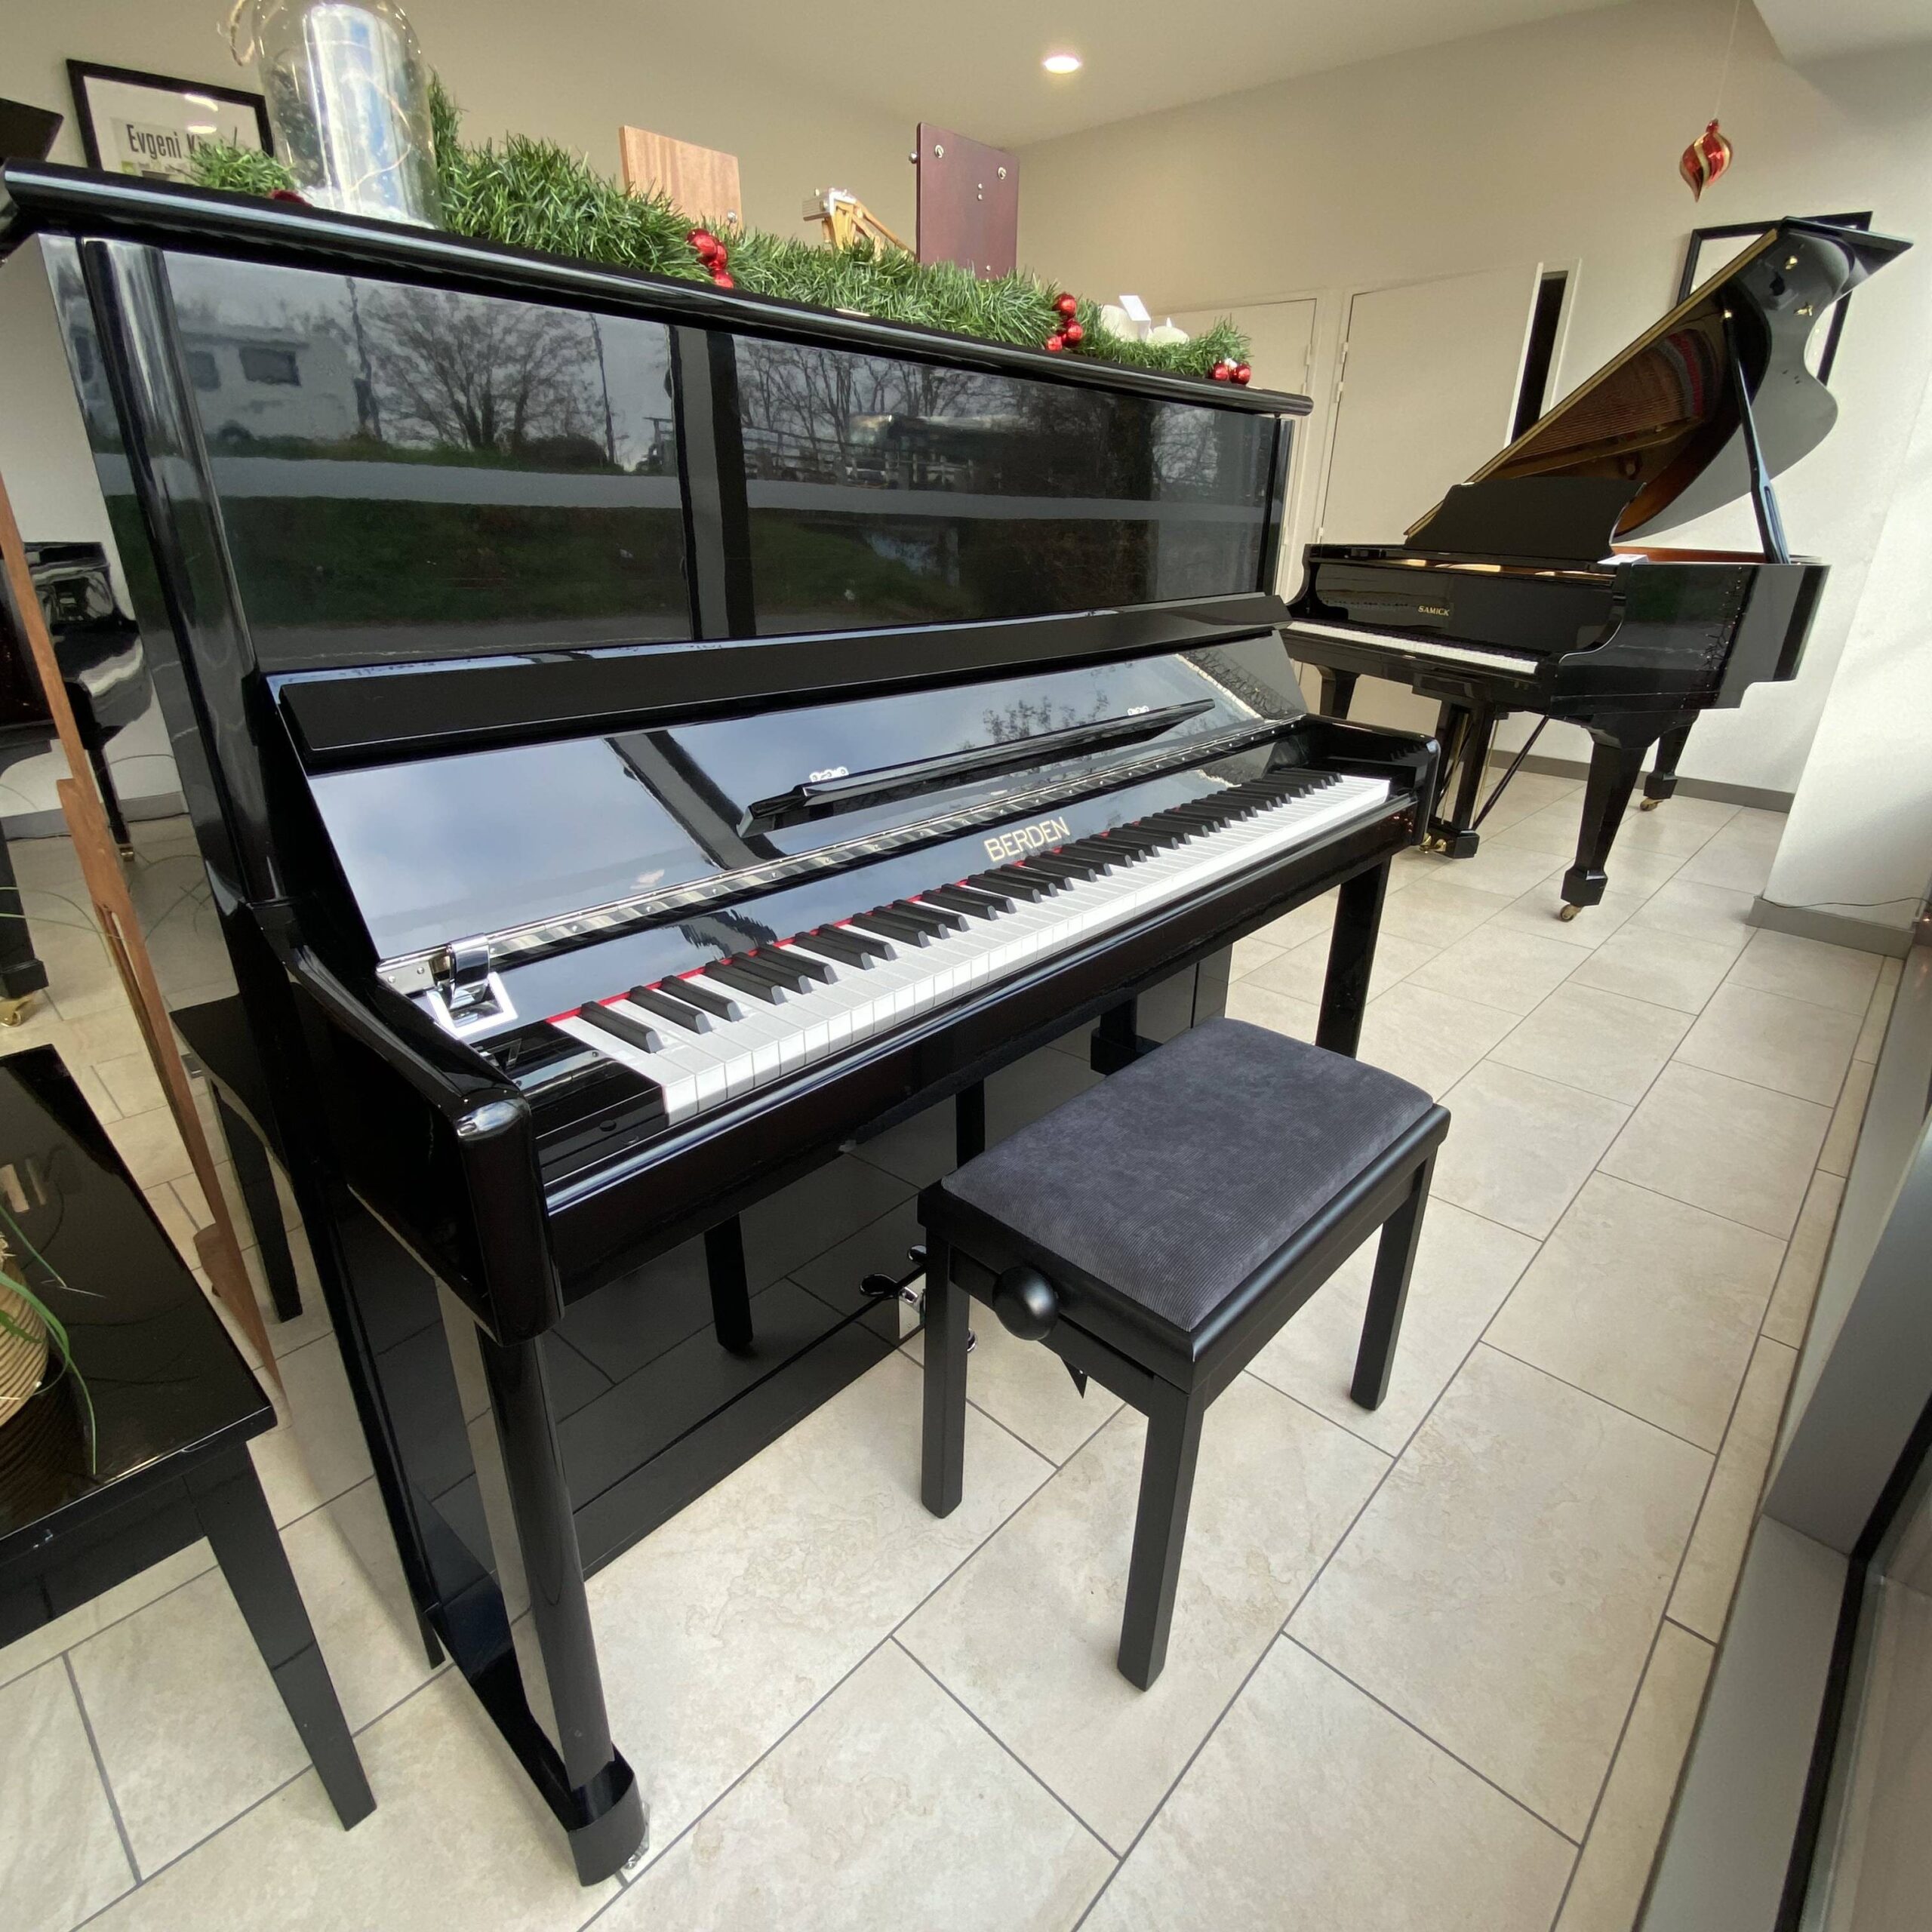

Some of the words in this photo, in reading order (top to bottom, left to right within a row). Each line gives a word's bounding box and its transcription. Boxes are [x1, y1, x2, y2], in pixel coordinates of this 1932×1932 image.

[126, 124, 182, 159] Evgeni
[1417, 605, 1450, 617] SAMICK
[983, 817, 1071, 862] BERDEN
